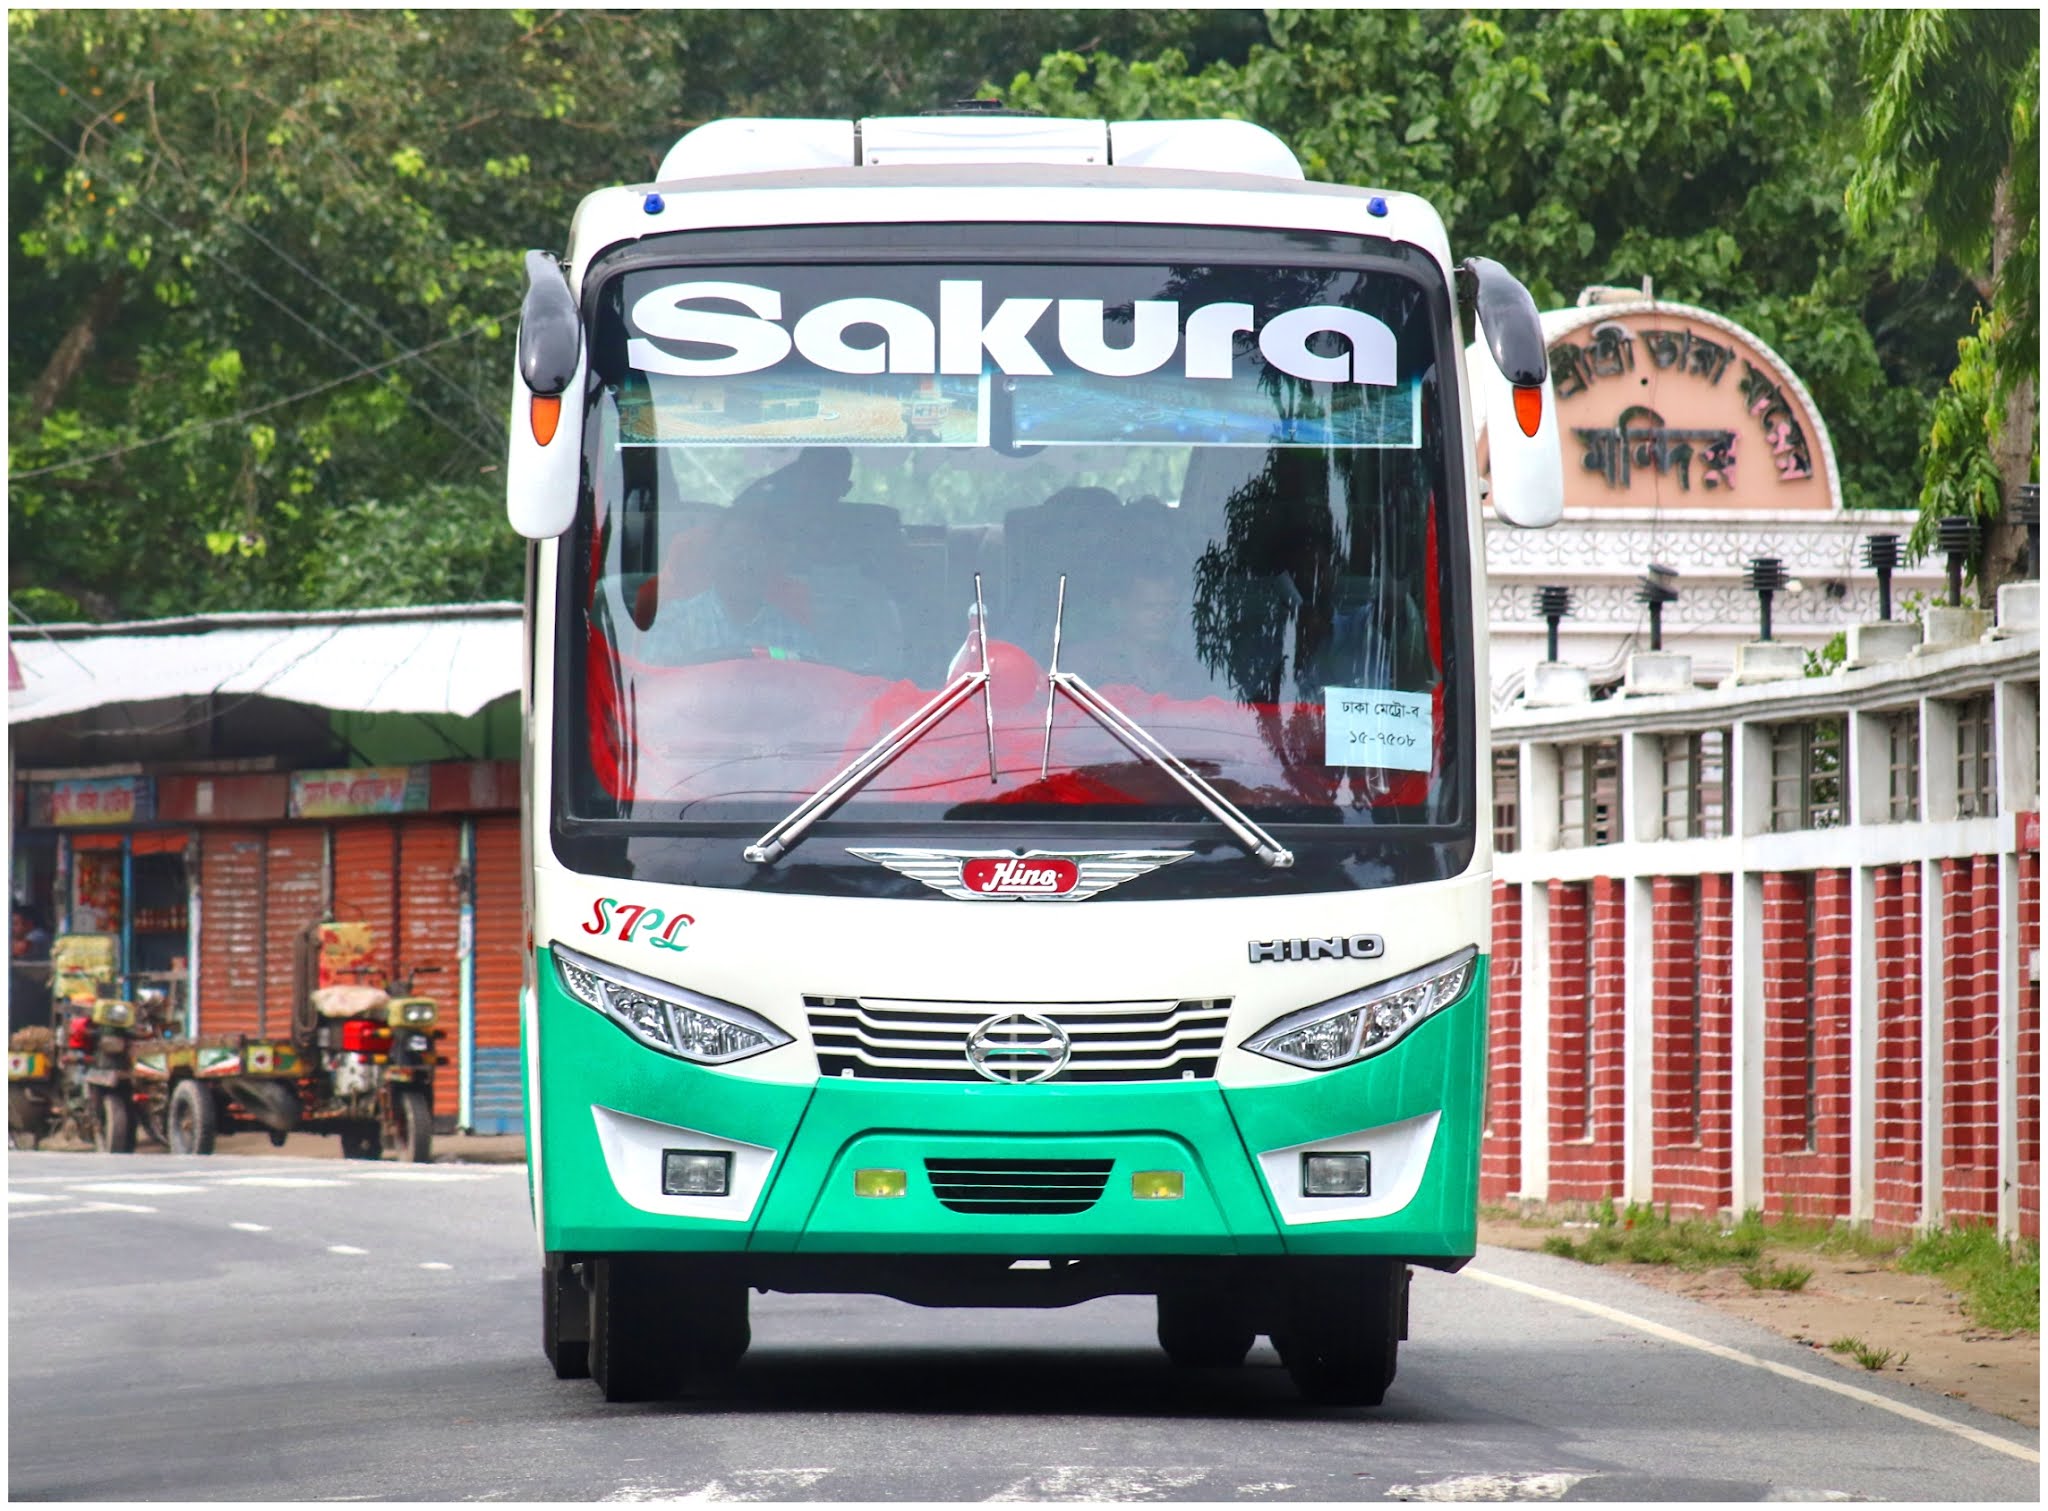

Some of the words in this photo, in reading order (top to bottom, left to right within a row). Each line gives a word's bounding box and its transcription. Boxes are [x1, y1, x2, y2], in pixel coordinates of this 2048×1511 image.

[628, 281, 1398, 386] Sakura
[1571, 406, 1741, 491] মন্দির
[1342, 701, 1368, 715] ঢাকা
[1349, 730, 1416, 747] ১৫-৭৫০৮
[982, 859, 1058, 892] Hino
[1248, 933, 1385, 963] HINO
